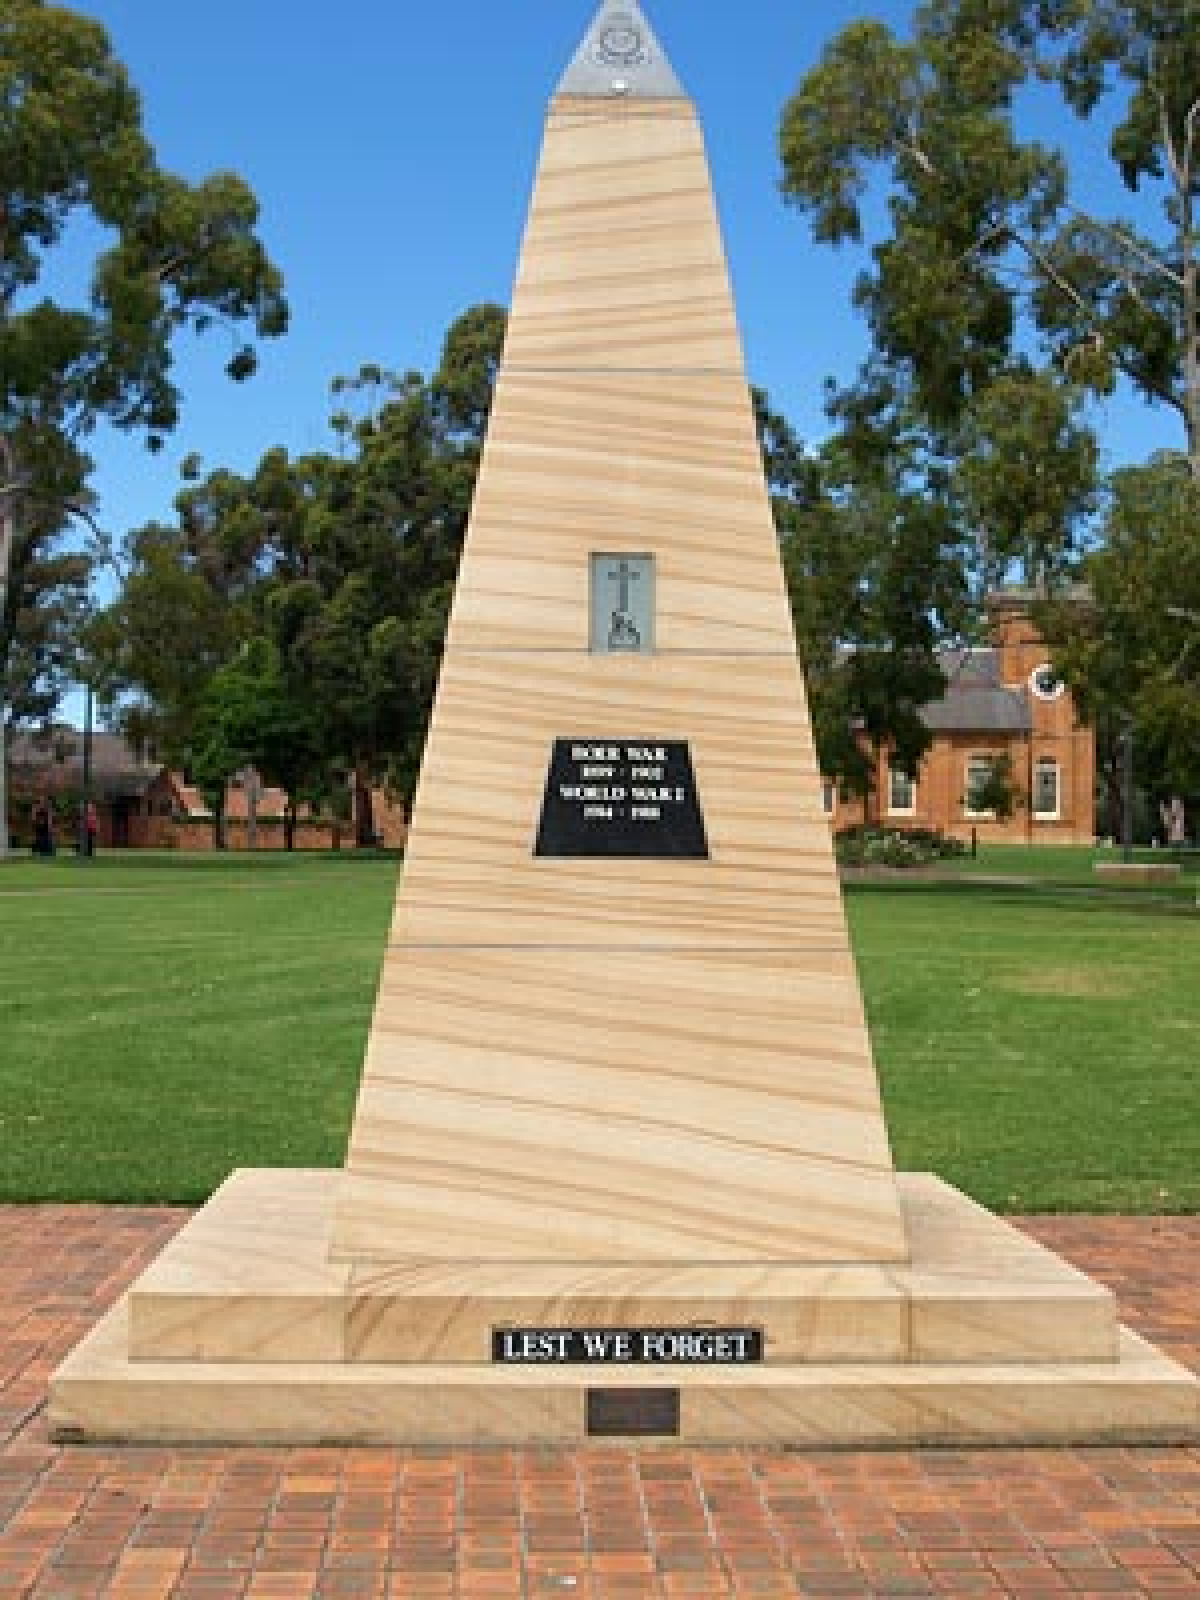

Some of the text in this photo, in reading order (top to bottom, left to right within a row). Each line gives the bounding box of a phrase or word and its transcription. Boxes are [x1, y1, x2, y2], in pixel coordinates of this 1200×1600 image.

[560, 785, 628, 801] WORLD
[632, 785, 673, 801] WAR
[504, 1332, 752, 1359] LEST WE FORGET
